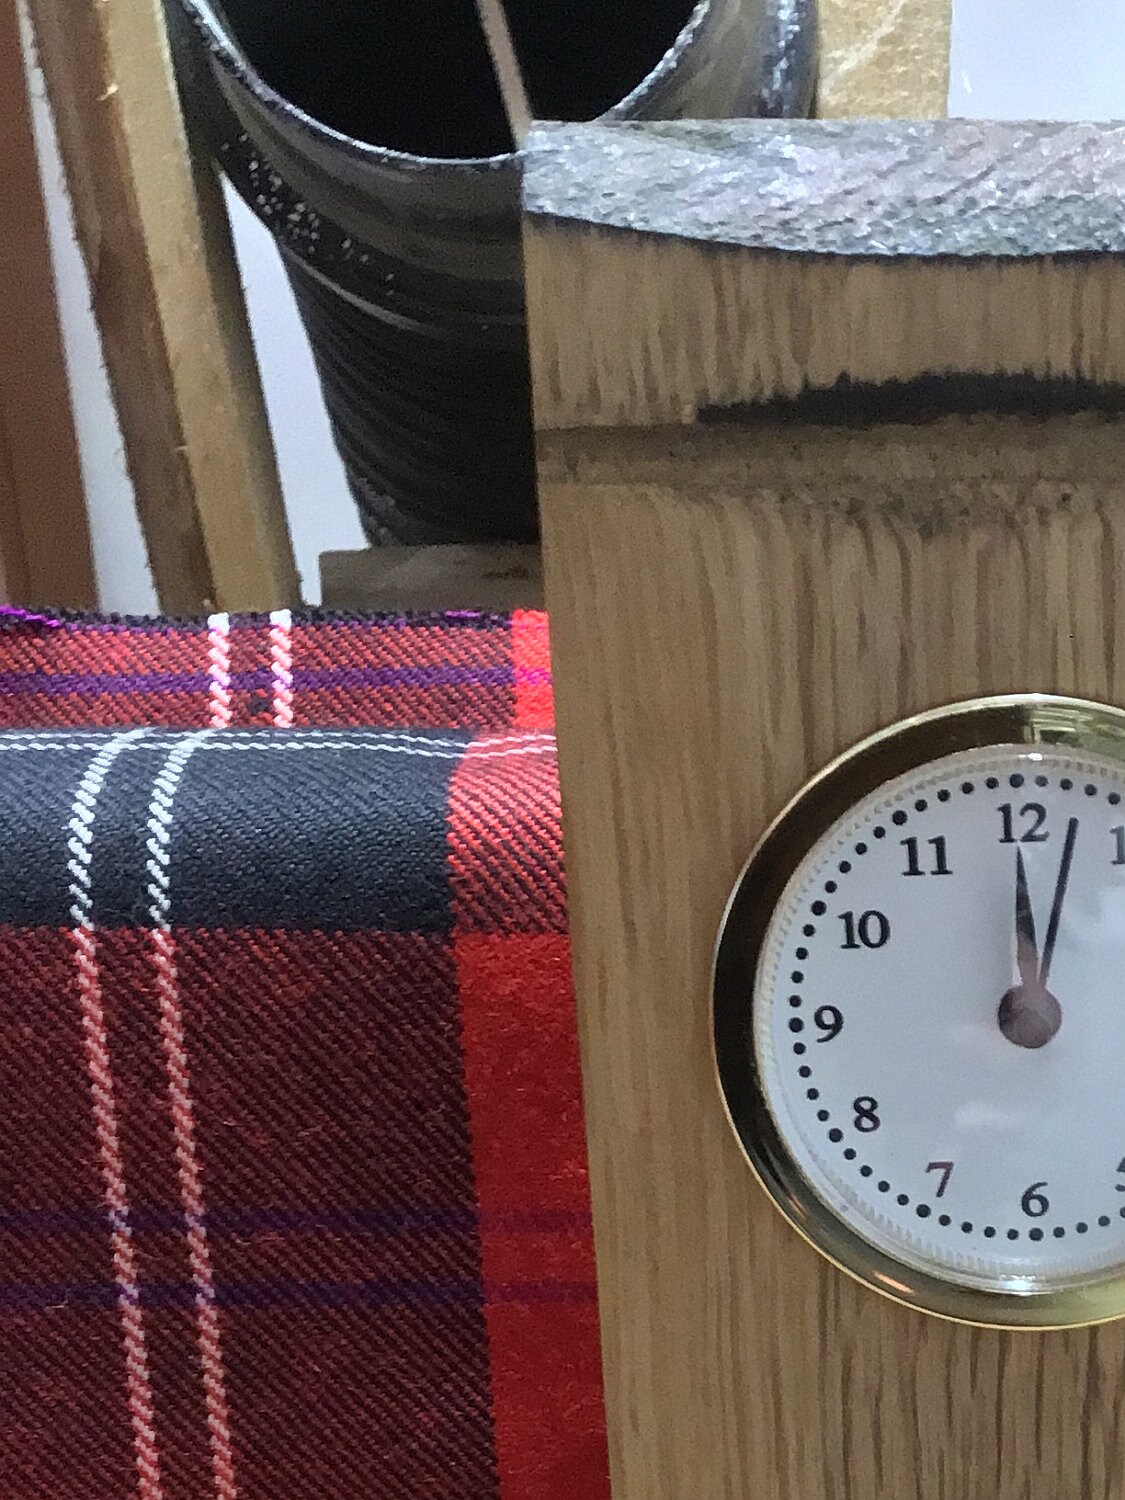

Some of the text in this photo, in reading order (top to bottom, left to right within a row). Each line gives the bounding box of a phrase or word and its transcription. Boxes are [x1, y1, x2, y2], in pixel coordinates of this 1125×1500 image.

[997, 802, 1050, 844] 12
[899, 836, 954, 877] 11
[837, 909, 891, 950] 10
[813, 1004, 845, 1044] 9
[852, 1095, 881, 1133] 8
[925, 1161, 955, 1199] 7
[1020, 1181, 1050, 1218] 6
